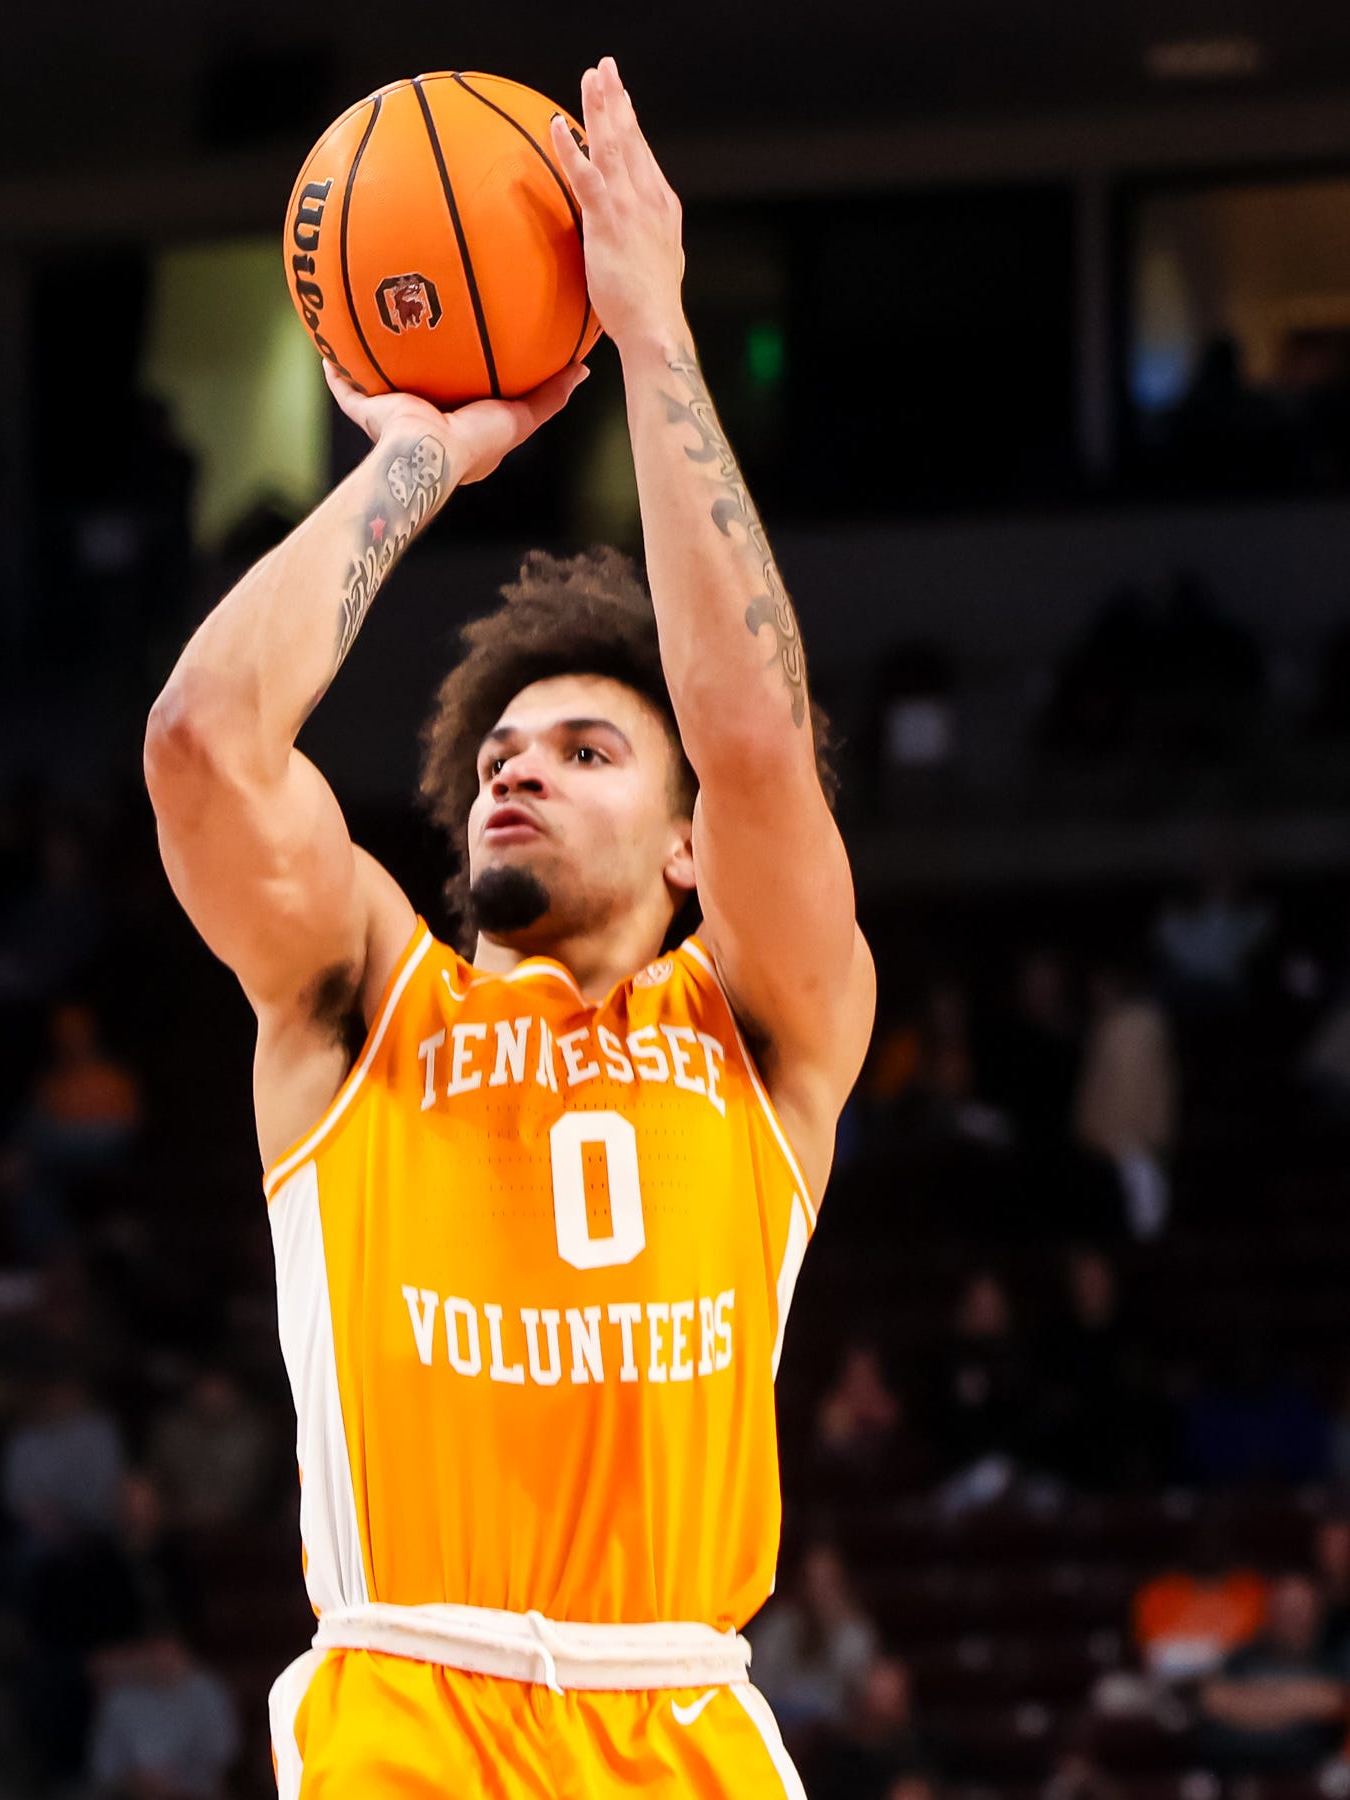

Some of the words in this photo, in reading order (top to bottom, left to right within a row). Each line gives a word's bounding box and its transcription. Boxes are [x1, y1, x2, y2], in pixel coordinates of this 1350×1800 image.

[418, 1016, 726, 1118] TENNESSEE
[549, 1111, 646, 1270] 0
[401, 1284, 736, 1387] VOLUNTEERS
